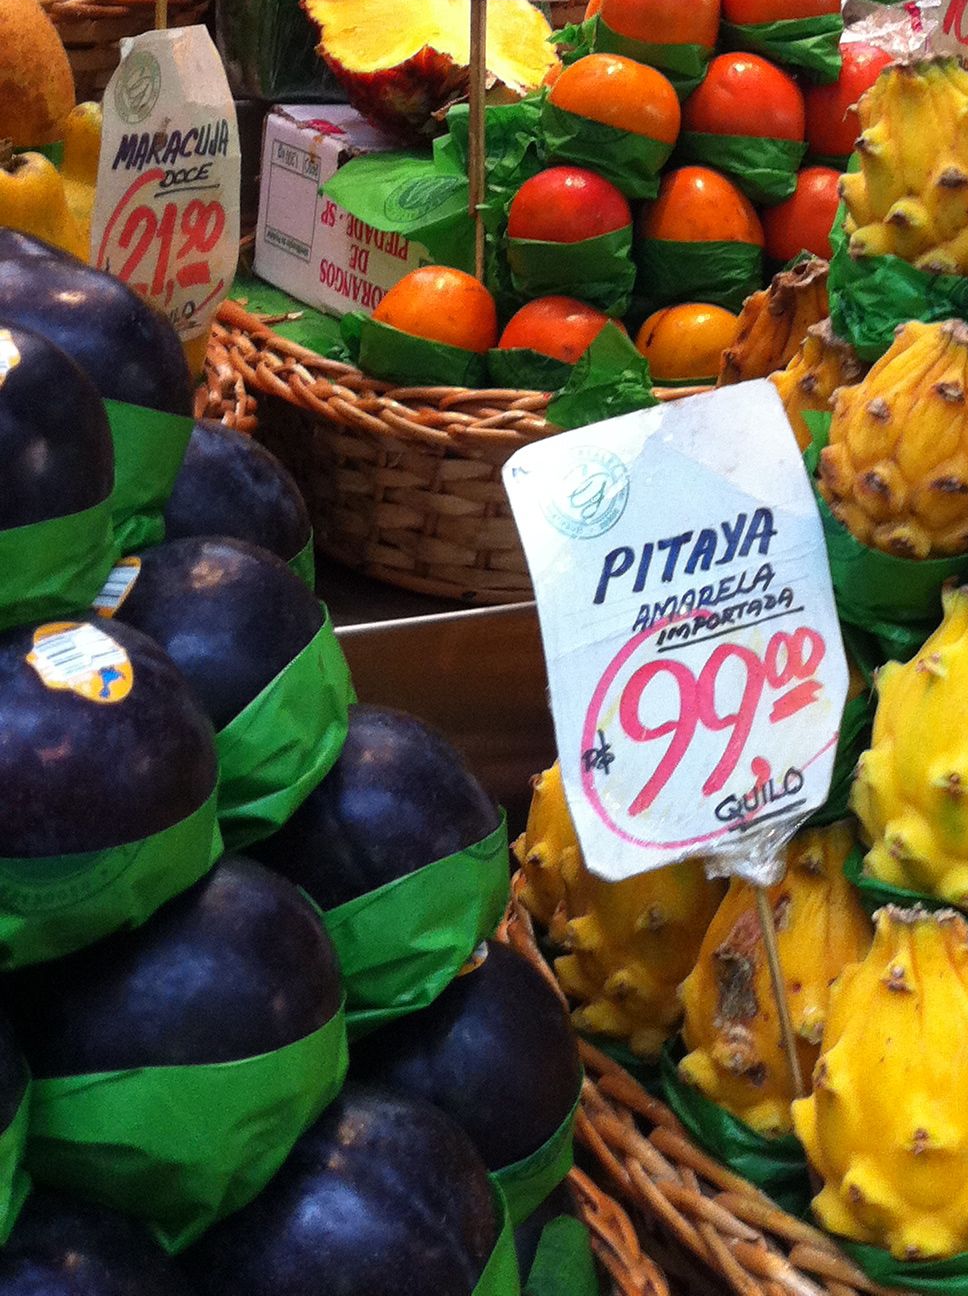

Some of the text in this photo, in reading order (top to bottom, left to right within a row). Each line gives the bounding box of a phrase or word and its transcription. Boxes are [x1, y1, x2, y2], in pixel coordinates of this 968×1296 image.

[159, 162, 213, 189] DOCE
[320, 200, 337, 228] SP
[319, 258, 386, 310] ORANGOS
[348, 243, 370, 275] DE
[593, 507, 778, 605] PITAYA
[632, 562, 776, 632] AMARELA
[656, 587, 794, 647] IMPORTADA
[715, 768, 804, 822] QUILO
